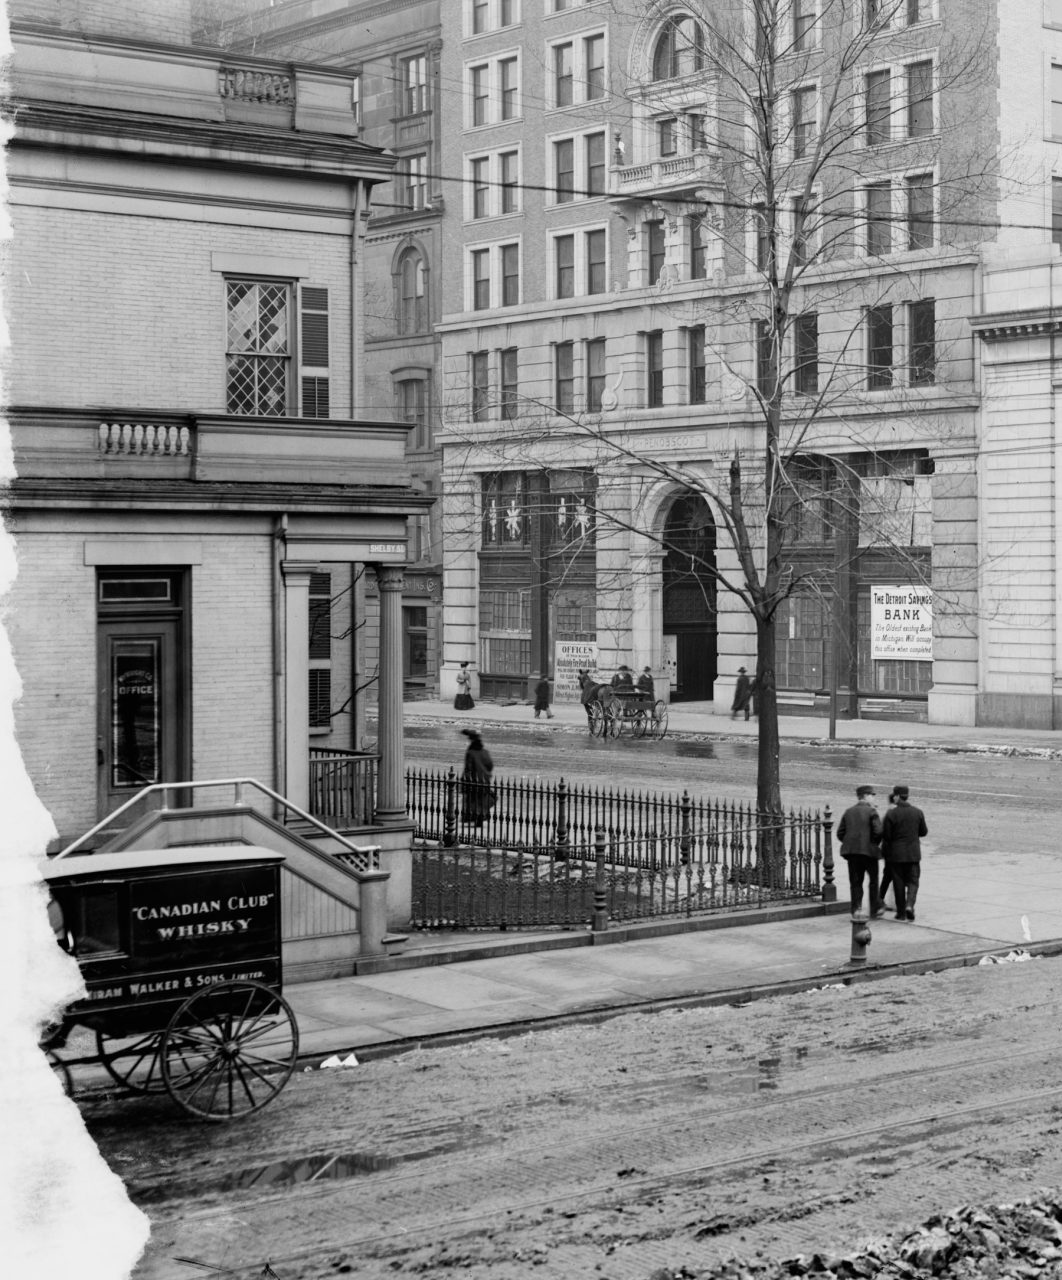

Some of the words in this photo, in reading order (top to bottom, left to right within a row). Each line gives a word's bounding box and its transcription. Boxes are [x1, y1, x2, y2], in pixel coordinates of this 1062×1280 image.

[370, 544, 395, 553] SHELBY
[874, 592, 884, 605] THE
[885, 592, 907, 605] DETROIT
[908, 593, 932, 605] SAVINGS
[884, 609, 920, 620] BANK
[875, 623, 885, 632] The
[885, 623, 902, 632] Oldest
[881, 634, 904, 644] Michigan
[906, 634, 915, 642] Will
[562, 646, 593, 654] OFFICES
[119, 685, 153, 695] OFFICE
[157, 917, 252, 941] WHISKY
[85, 985, 123, 1001] HIRAM
[129, 979, 180, 996] WALKER
[184, 975, 193, 988] &
[196, 973, 226, 987] SONS
